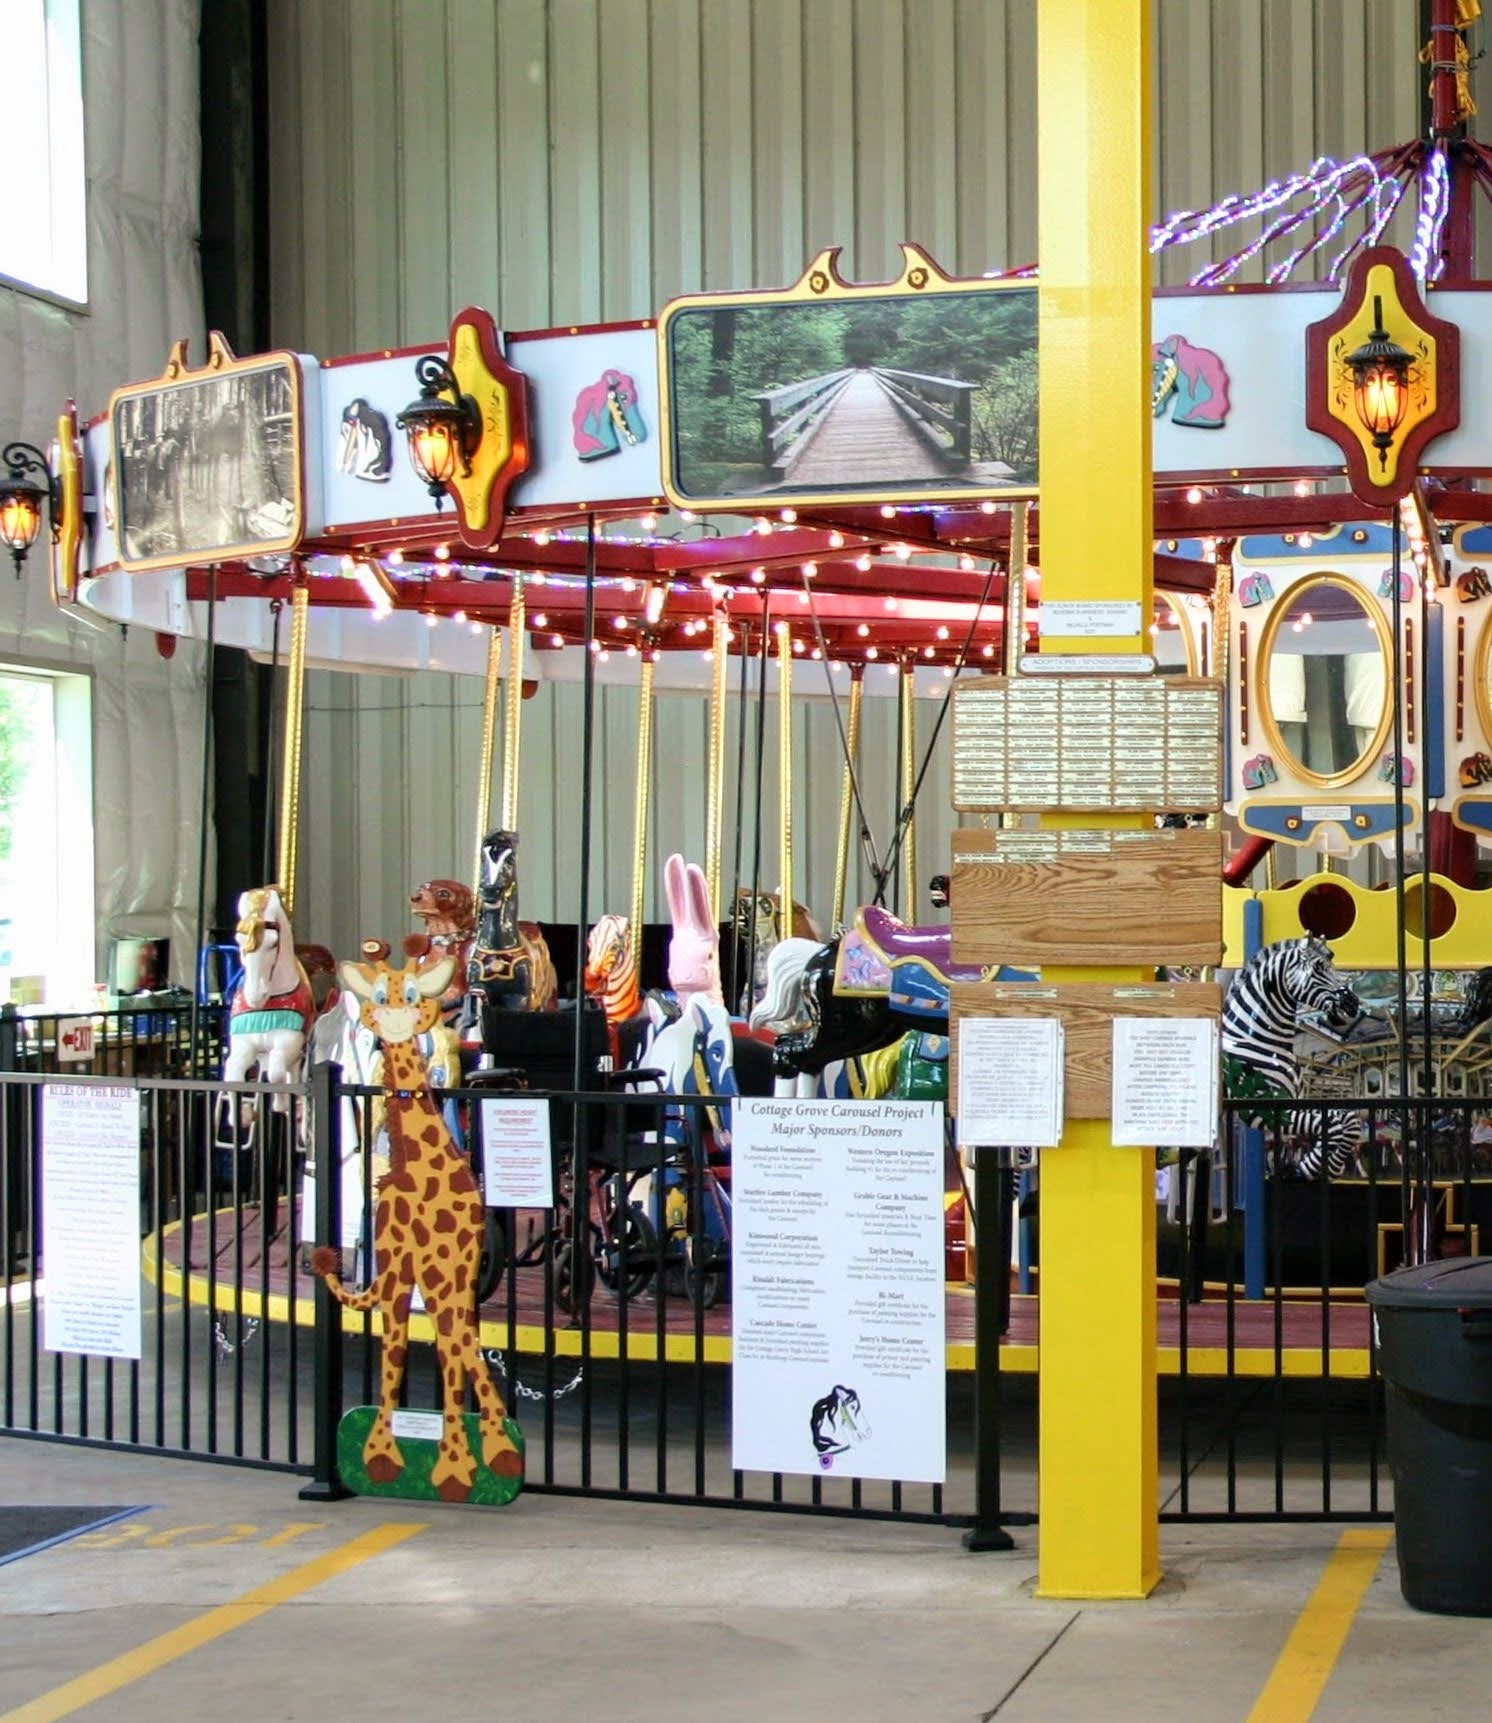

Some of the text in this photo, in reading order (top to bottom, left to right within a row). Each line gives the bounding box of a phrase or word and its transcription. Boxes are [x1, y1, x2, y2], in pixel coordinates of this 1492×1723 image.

[75, 1026, 91, 1051] EXIT
[50, 1085, 133, 1098] RULES OF THE RIDE
[751, 1103, 924, 1122] Cottage Grove Carousel Project
[771, 1122, 903, 1139] Major Sponsors/Donors
